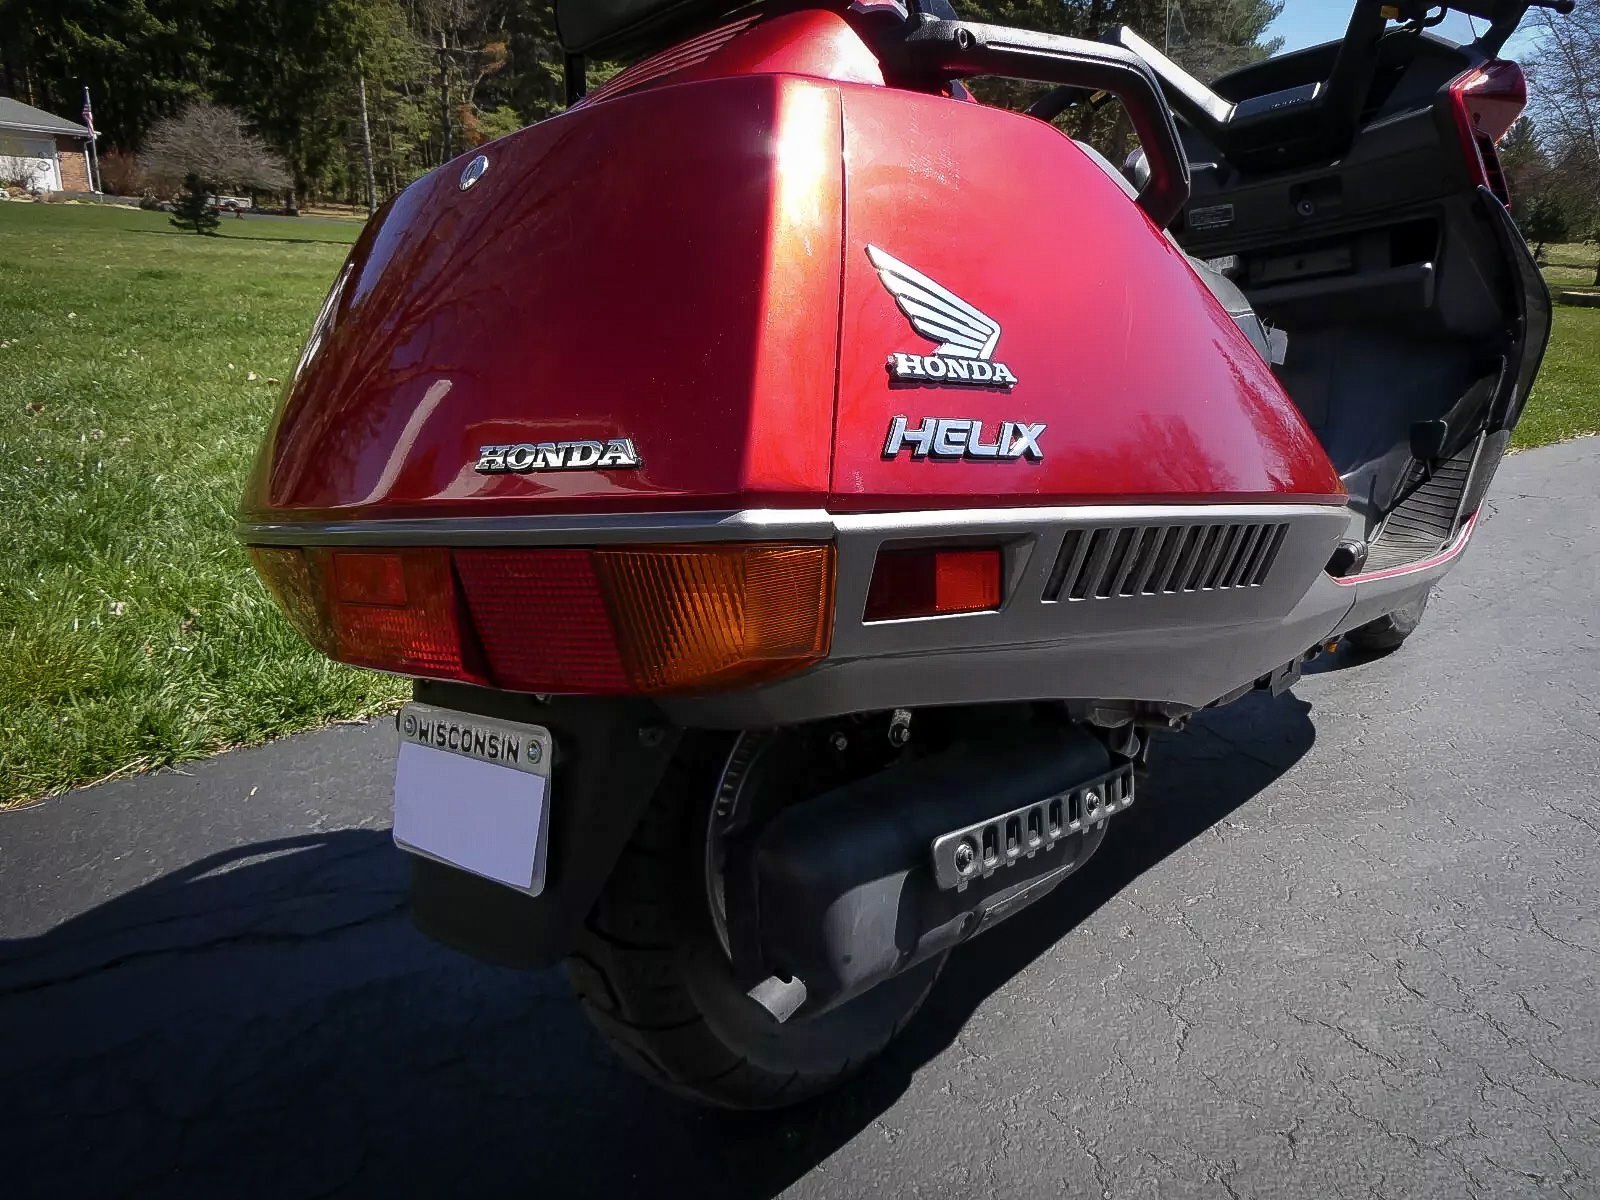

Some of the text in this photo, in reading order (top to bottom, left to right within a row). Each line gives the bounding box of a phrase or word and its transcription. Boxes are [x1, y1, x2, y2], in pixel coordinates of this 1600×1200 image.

[888, 352, 1018, 386] HONDA
[474, 438, 639, 472] HONDA
[881, 414, 1047, 459] HELIX
[418, 719, 520, 763] WISCONSIN
